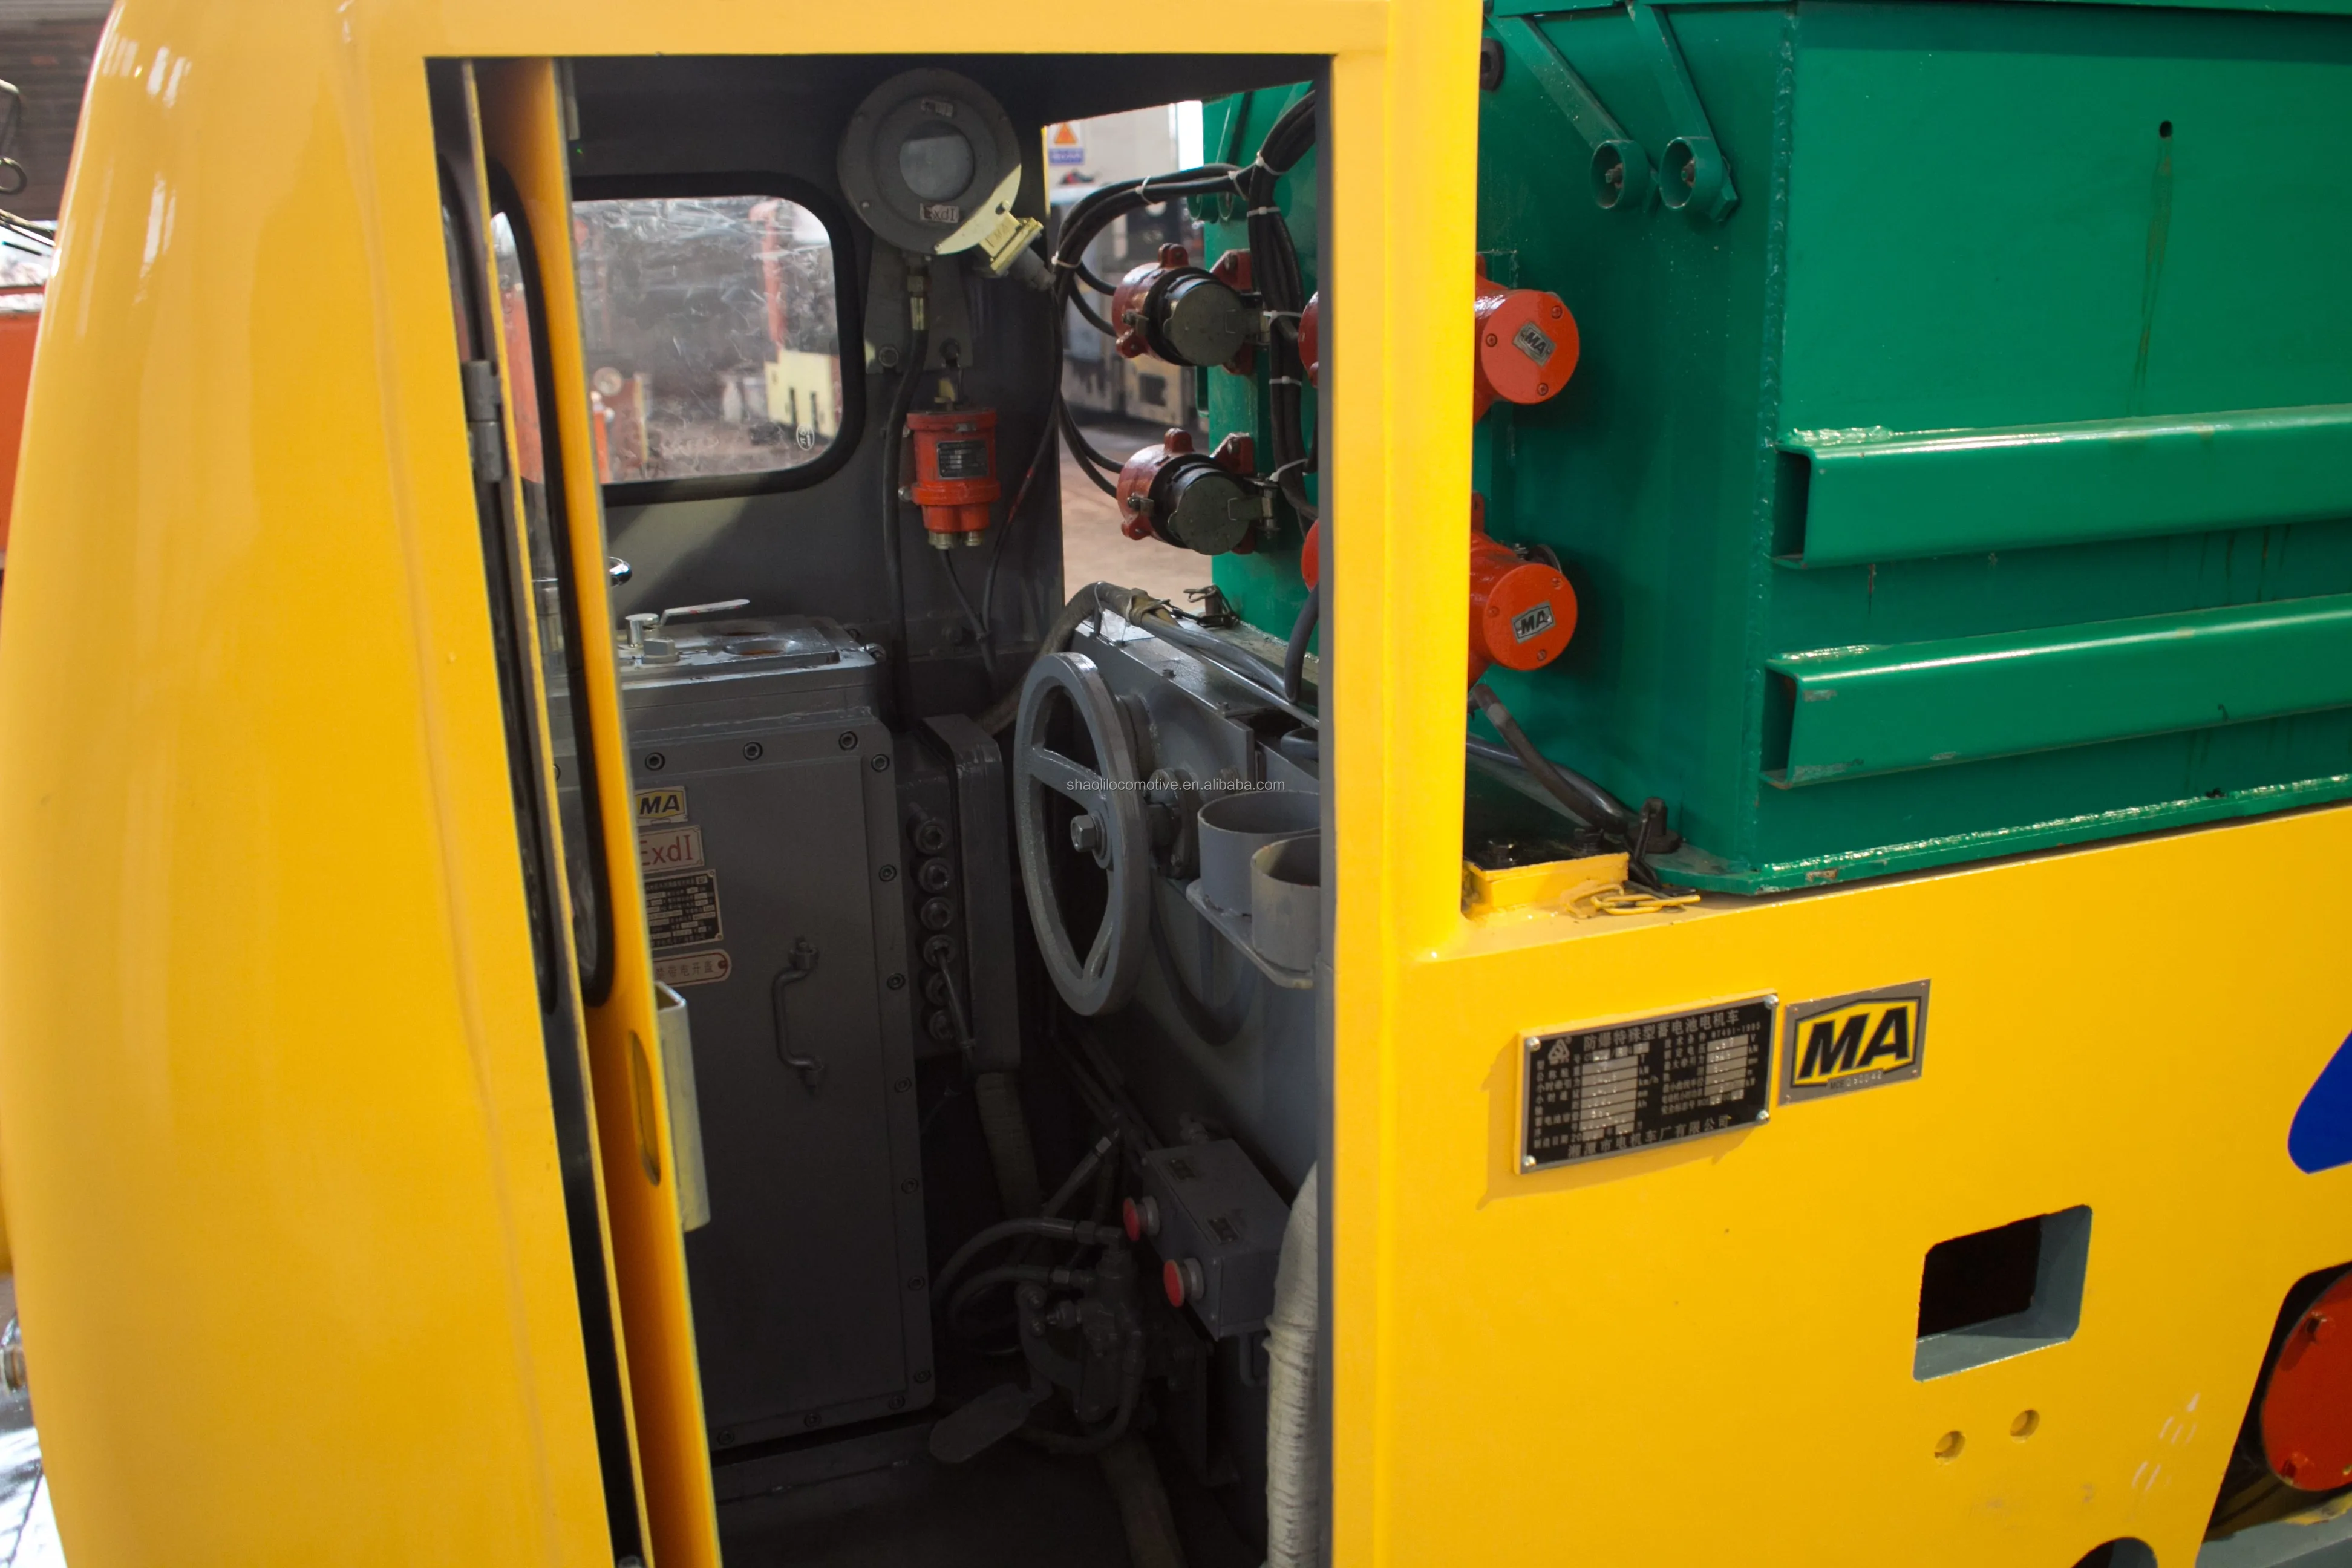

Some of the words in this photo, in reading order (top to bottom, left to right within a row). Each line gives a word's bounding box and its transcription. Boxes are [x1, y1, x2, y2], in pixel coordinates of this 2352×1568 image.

[1524, 332, 1547, 355] MA
[1520, 610, 1549, 635] MA
[640, 795, 679, 815] MA
[1798, 1005, 1910, 1080] MA
